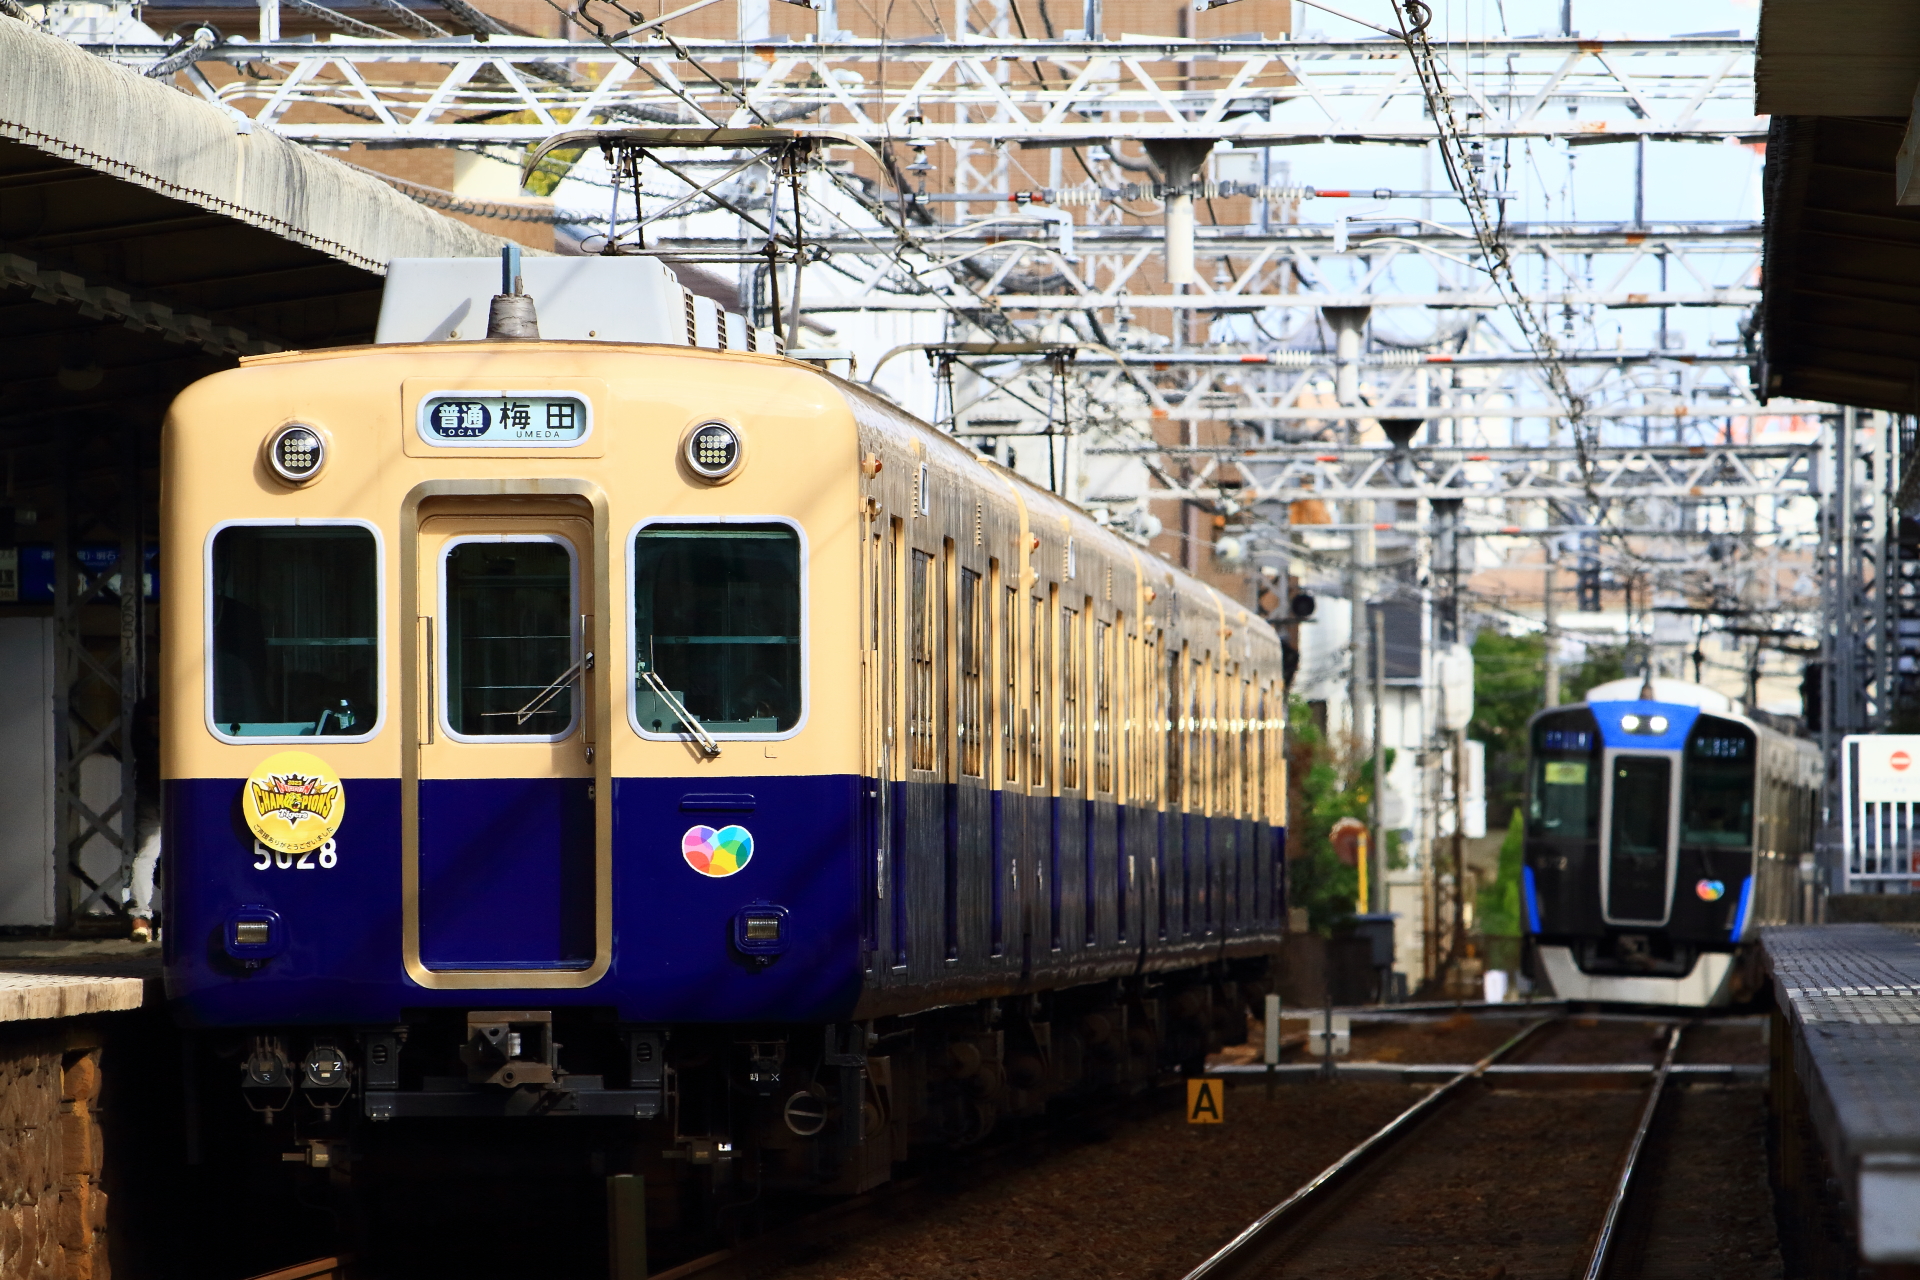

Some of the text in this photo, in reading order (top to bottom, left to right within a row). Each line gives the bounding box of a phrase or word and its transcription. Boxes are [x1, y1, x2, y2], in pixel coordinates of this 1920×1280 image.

[439, 402, 575, 430] 普通 梅田
[516, 430, 561, 438] UMEDA
[252, 782, 338, 819] CHAMPIONS
[311, 1062, 319, 1072] Y
[1192, 1083, 1219, 1119] A
